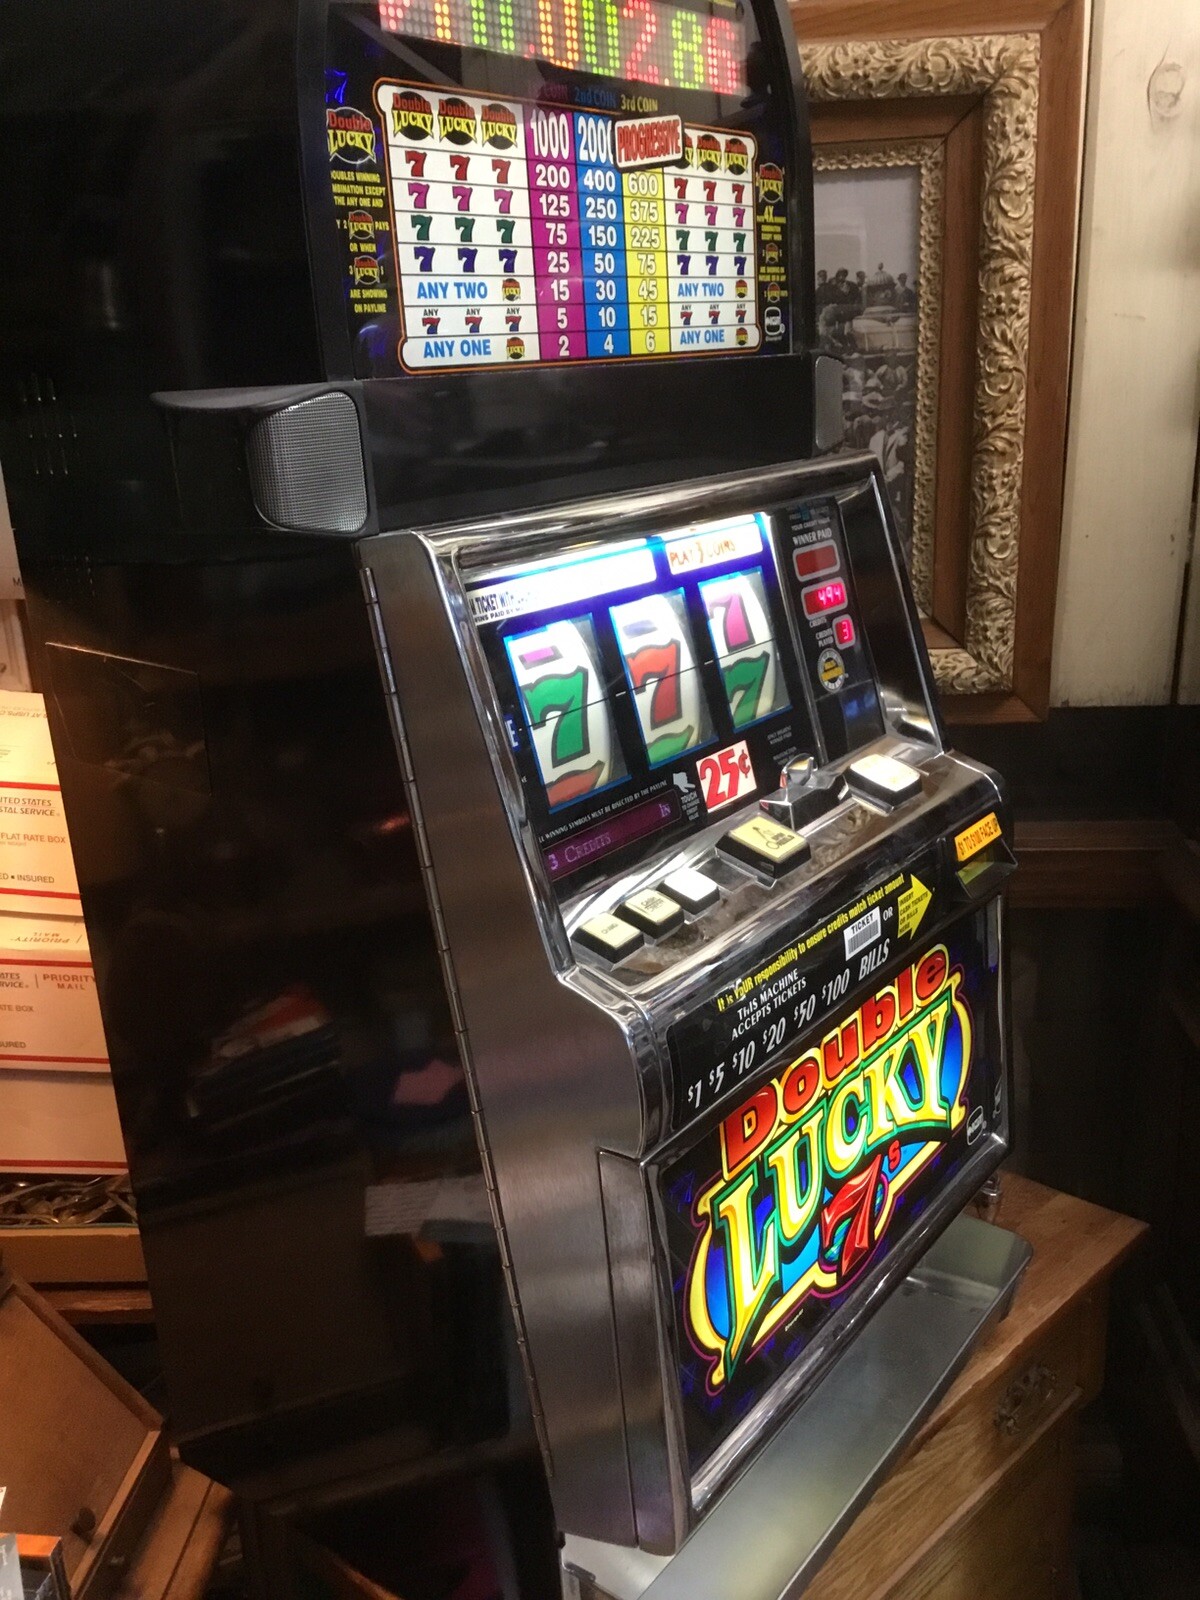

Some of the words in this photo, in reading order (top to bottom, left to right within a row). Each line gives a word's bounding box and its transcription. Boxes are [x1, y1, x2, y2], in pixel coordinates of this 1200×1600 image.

[621, 94, 635, 111] 3rd
[637, 96, 658, 112] COIN
[327, 130, 374, 157] LUCKY
[392, 110, 434, 137] LUCKY
[438, 115, 477, 142] LUCKY
[481, 121, 517, 147] LUCKY
[531, 109, 570, 160] 1000
[617, 119, 681, 163] PROGRESSIVE
[405, 150, 427, 177] 7
[450, 154, 470, 181] 7
[492, 159, 511, 184] 7
[535, 164, 570, 188] 200
[584, 169, 616, 192] 400
[628, 173, 658, 196] 600
[365, 186, 386, 196] EXCEPT
[408, 182, 430, 209] 7
[452, 185, 473, 211] 7
[494, 188, 513, 214] 7
[539, 194, 569, 218] 125
[585, 197, 617, 220] 250
[630, 200, 659, 222] 375
[546, 223, 568, 245] 75
[588, 225, 617, 247] 150
[631, 226, 661, 249] 225
[547, 251, 570, 274] 25
[594, 252, 615, 274] 50
[637, 253, 656, 275] 75
[417, 282, 449, 299] ANY
[454, 282, 488, 299] TWO
[551, 279, 569, 301] 15
[596, 279, 616, 301] 30
[638, 279, 658, 300] 45
[678, 283, 699, 297] ANY
[702, 282, 724, 297] TWO
[423, 308, 439, 316] ANY
[557, 307, 568, 329] 5
[598, 306, 616, 328] 10
[641, 305, 658, 326] 15
[423, 340, 455, 358] ANY
[460, 339, 492, 357] ONE
[559, 334, 569, 356] 2
[604, 333, 614, 354] 4
[645, 331, 656, 351] 6
[680, 330, 701, 344] ANY
[704, 329, 725, 343] ONE
[792, 531, 817, 546] WINNER
[817, 528, 833, 541] PAID
[475, 593, 498, 615] TICKET
[818, 584, 842, 605] 494
[490, 610, 505, 620] PAID
[809, 617, 827, 628] CREDITS
[842, 621, 849, 640] 3
[520, 665, 590, 768] 7
[624, 638, 683, 730] 7
[722, 650, 771, 729] 7
[700, 748, 750, 810] 25¢
[20, 808, 55, 817] SERVICE
[22, 798, 52, 807] STATES
[545, 825, 568, 839] WINNING
[569, 814, 591, 829] SYMBOLS
[591, 808, 604, 818] MUST
[634, 792, 640, 800] BY
[640, 787, 649, 796] THE
[650, 780, 668, 792] PAYLINE
[1, 832, 20, 841] FLAT
[23, 834, 45, 842] RATE
[47, 835, 66, 843] BOX
[979, 821, 994, 839] FACE
[17, 874, 55, 884] INSURED
[851, 912, 874, 935] TICKET
[882, 906, 893, 921] OR
[717, 997, 726, 1012] It
[726, 991, 734, 1004] is
[733, 975, 754, 1000] YOUR
[754, 950, 799, 985] responsibility
[798, 942, 806, 955] to
[805, 930, 827, 948] ensure
[827, 913, 849, 934] credits
[849, 898, 868, 921] match
[866, 889, 885, 909] ticket
[884, 873, 905, 899] amount
[43, 973, 96, 982] PRIORITY
[737, 998, 758, 1021] THIS
[760, 968, 798, 1001] MACHINE
[731, 1002, 771, 1041] ACCEPTS
[774, 977, 807, 1009] TICKETS
[687, 1080, 702, 1109] $1
[709, 1061, 725, 1093] $5
[732, 1040, 756, 1075] $10
[762, 1016, 786, 1053] $20
[794, 994, 816, 1029] $50
[822, 968, 850, 1006] $100
[858, 938, 890, 981] BILLS
[720, 944, 949, 1179] Double
[714, 988, 952, 1378] LUCKY
